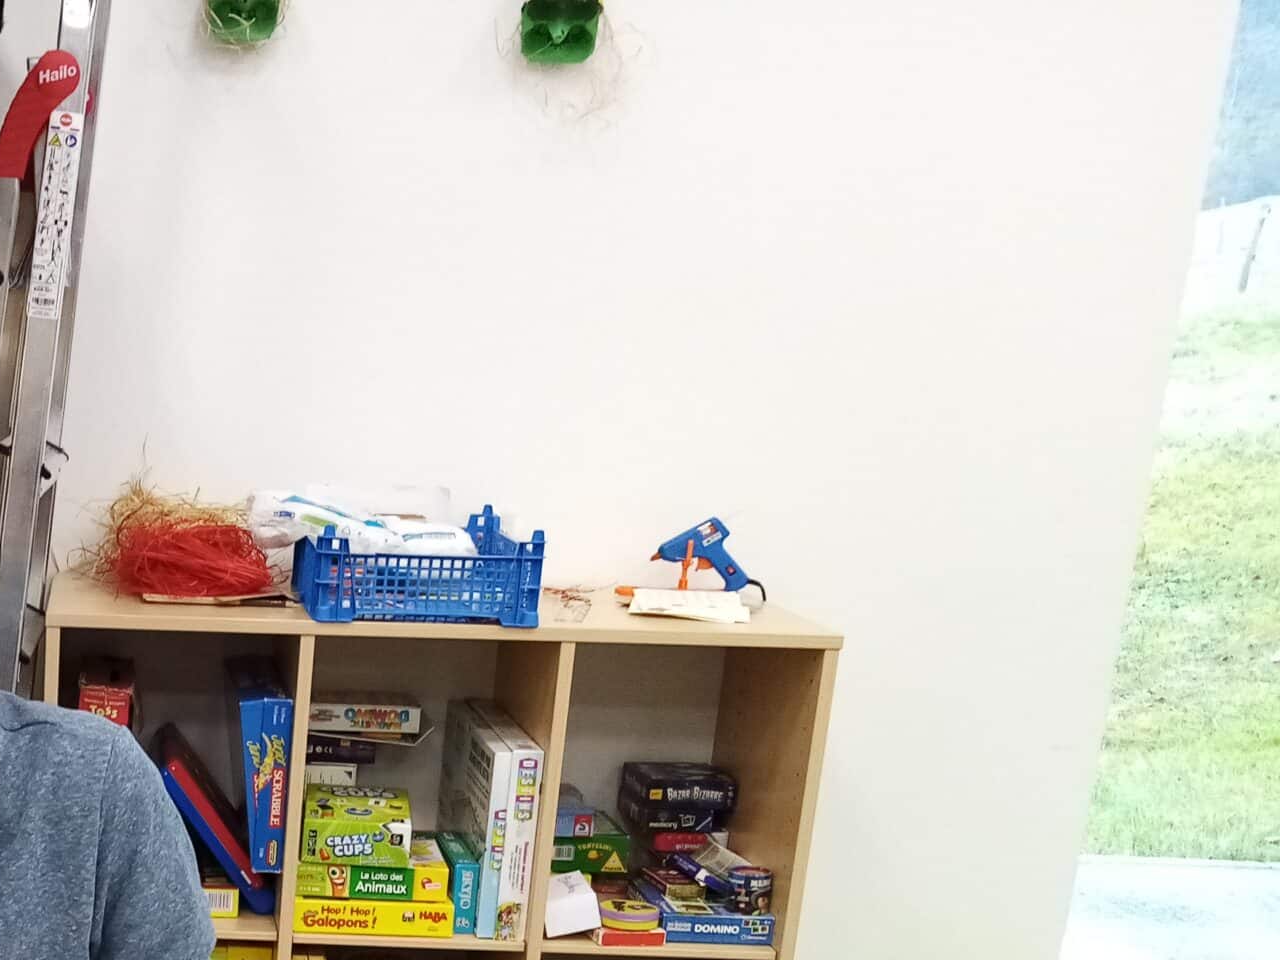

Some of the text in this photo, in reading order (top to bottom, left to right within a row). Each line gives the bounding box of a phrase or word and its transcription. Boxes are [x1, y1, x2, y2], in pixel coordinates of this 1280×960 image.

[514, 757, 538, 822] DESTINS
[270, 768, 284, 827] SCRABBLE
[326, 834, 369, 847] CRAZY
[333, 843, 374, 858] CUPS
[371, 872, 389, 881] Loto
[389, 872, 404, 882] des
[355, 881, 407, 895] Animaux
[420, 911, 447, 924] HABA
[694, 924, 740, 935] DOMINO
